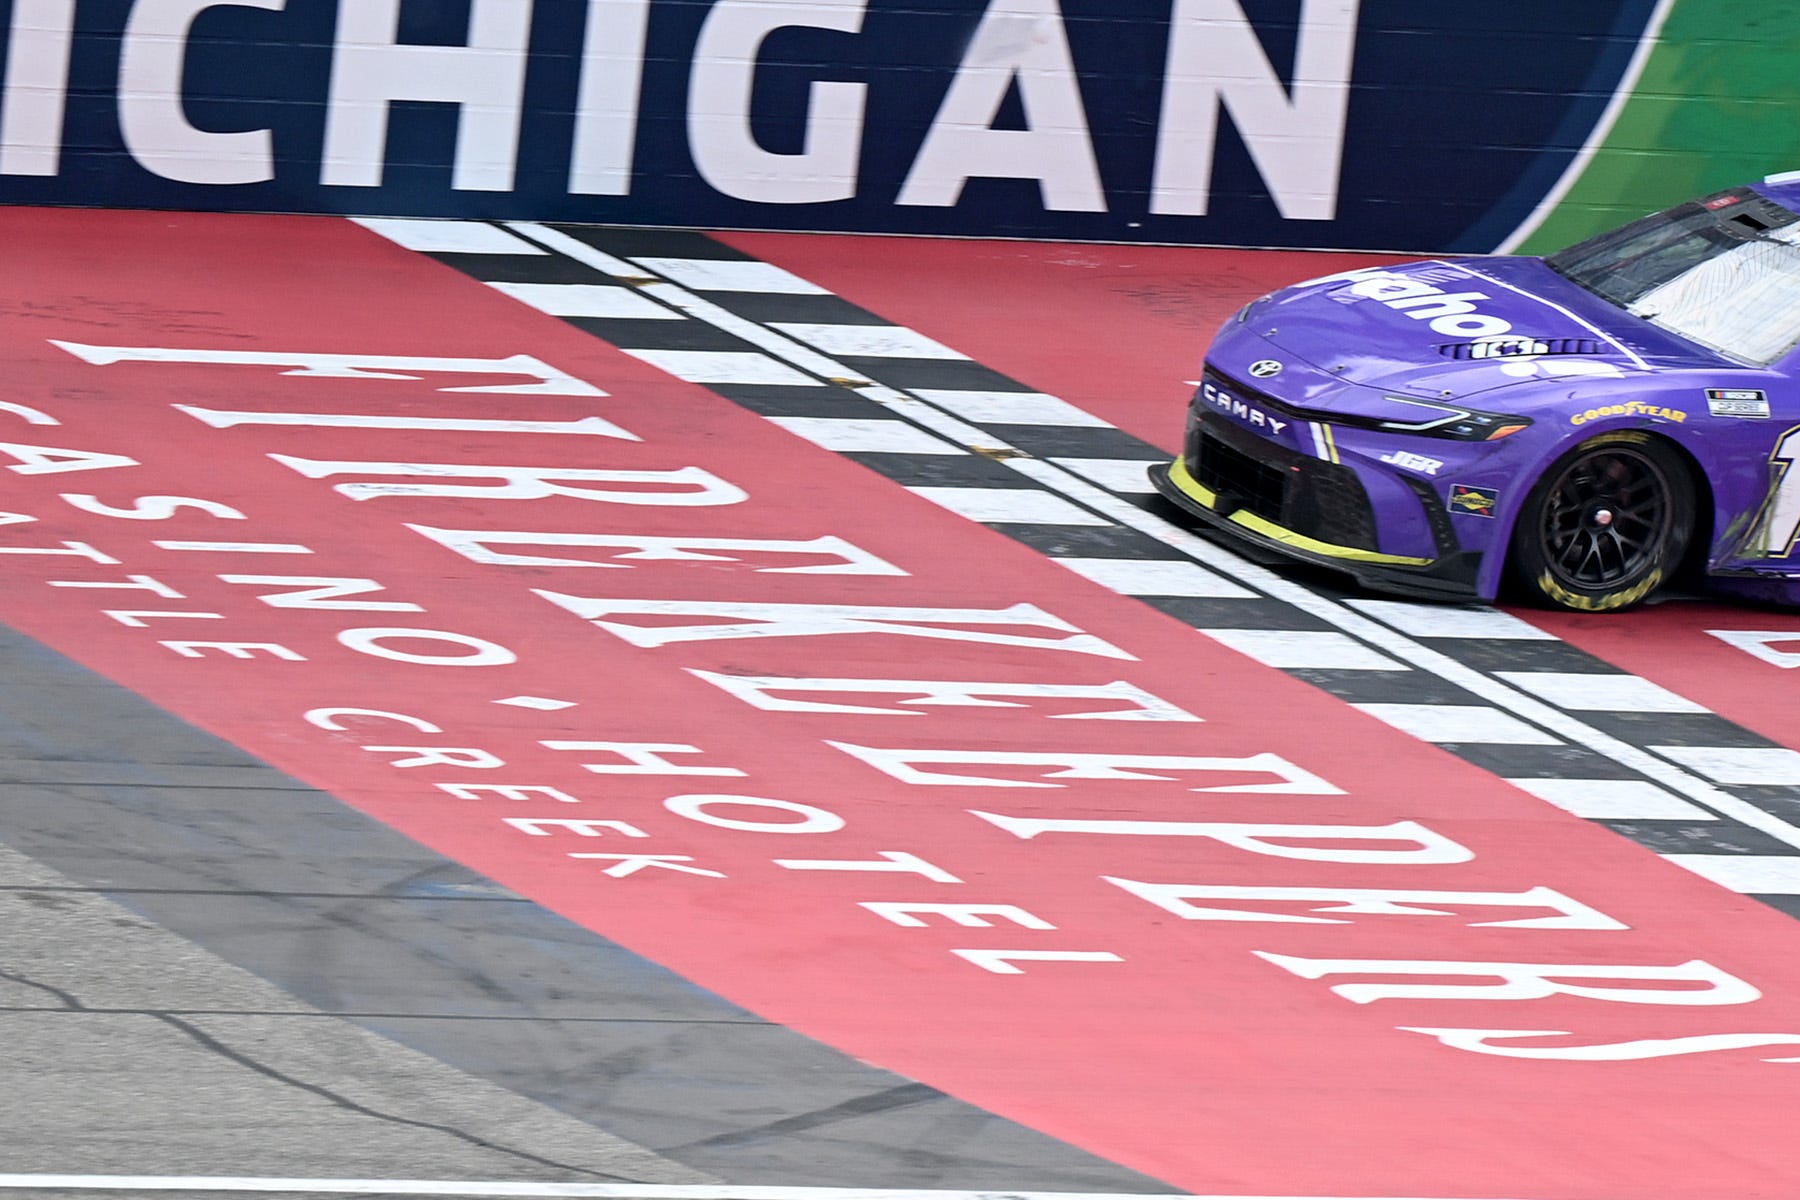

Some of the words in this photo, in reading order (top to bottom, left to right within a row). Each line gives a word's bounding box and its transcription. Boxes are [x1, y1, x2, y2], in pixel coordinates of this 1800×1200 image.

[1203, 383, 1287, 435] CAMRY
[1570, 401, 1687, 426] GOODYEAR
[1380, 450, 1444, 475] JGR
[303, 707, 727, 878] CREEK
[538, 740, 1127, 975] HOTEL
